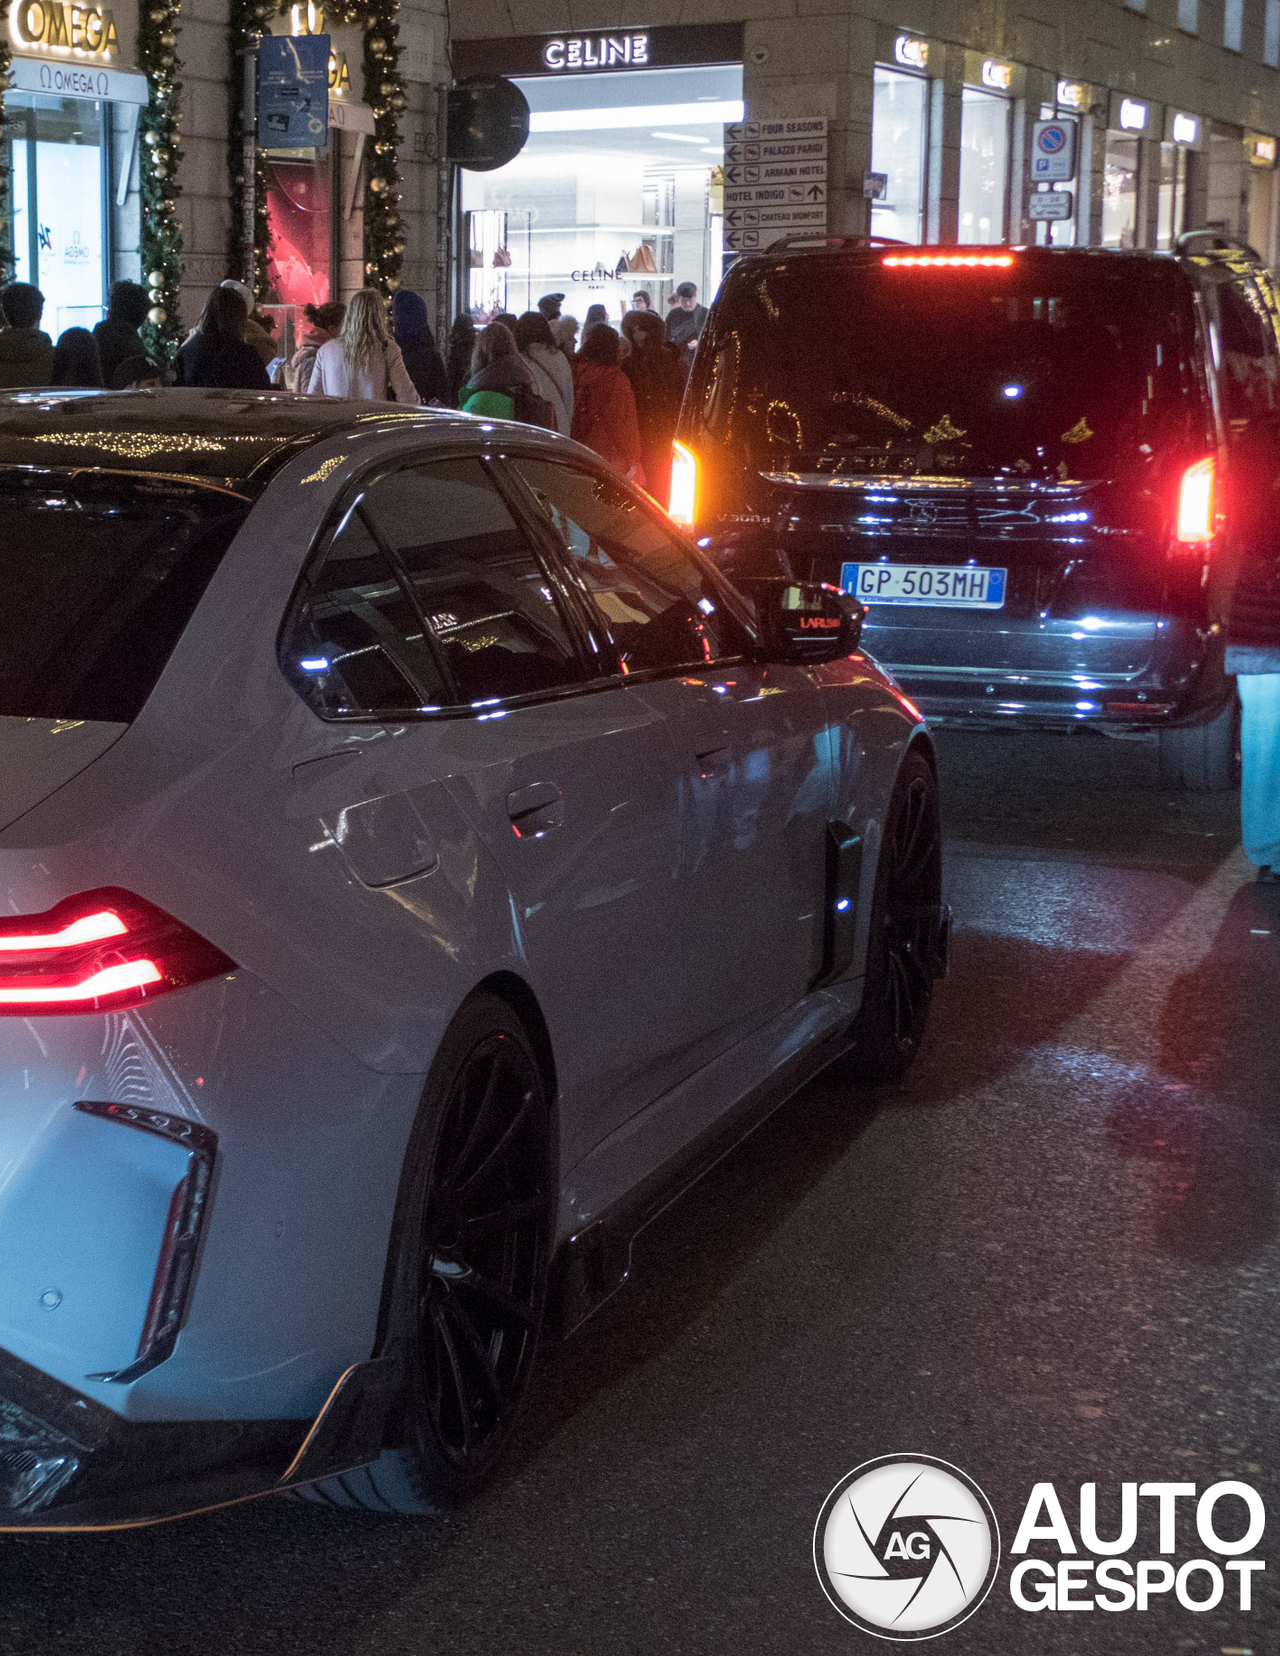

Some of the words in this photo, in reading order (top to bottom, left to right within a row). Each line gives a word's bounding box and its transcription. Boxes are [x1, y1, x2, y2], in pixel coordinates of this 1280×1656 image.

[15, 0, 119, 54] OMEGA
[544, 36, 648, 68] CELINE
[54, 71, 95, 94] OMEGA
[761, 124, 784, 134] FOUR
[786, 121, 823, 133] SEASONS
[763, 145, 796, 156] PALAZZO
[764, 167, 797, 177] ARMANI
[799, 165, 825, 176] HOTEL
[726, 191, 753, 202] HOTEL
[755, 189, 784, 200] INDIGO
[761, 212, 791, 222] CHATEAU
[791, 210, 825, 220] MONFORT
[571, 269, 623, 281] CELINE
[860, 569, 892, 594] GP
[901, 570, 986, 598] 503MH
